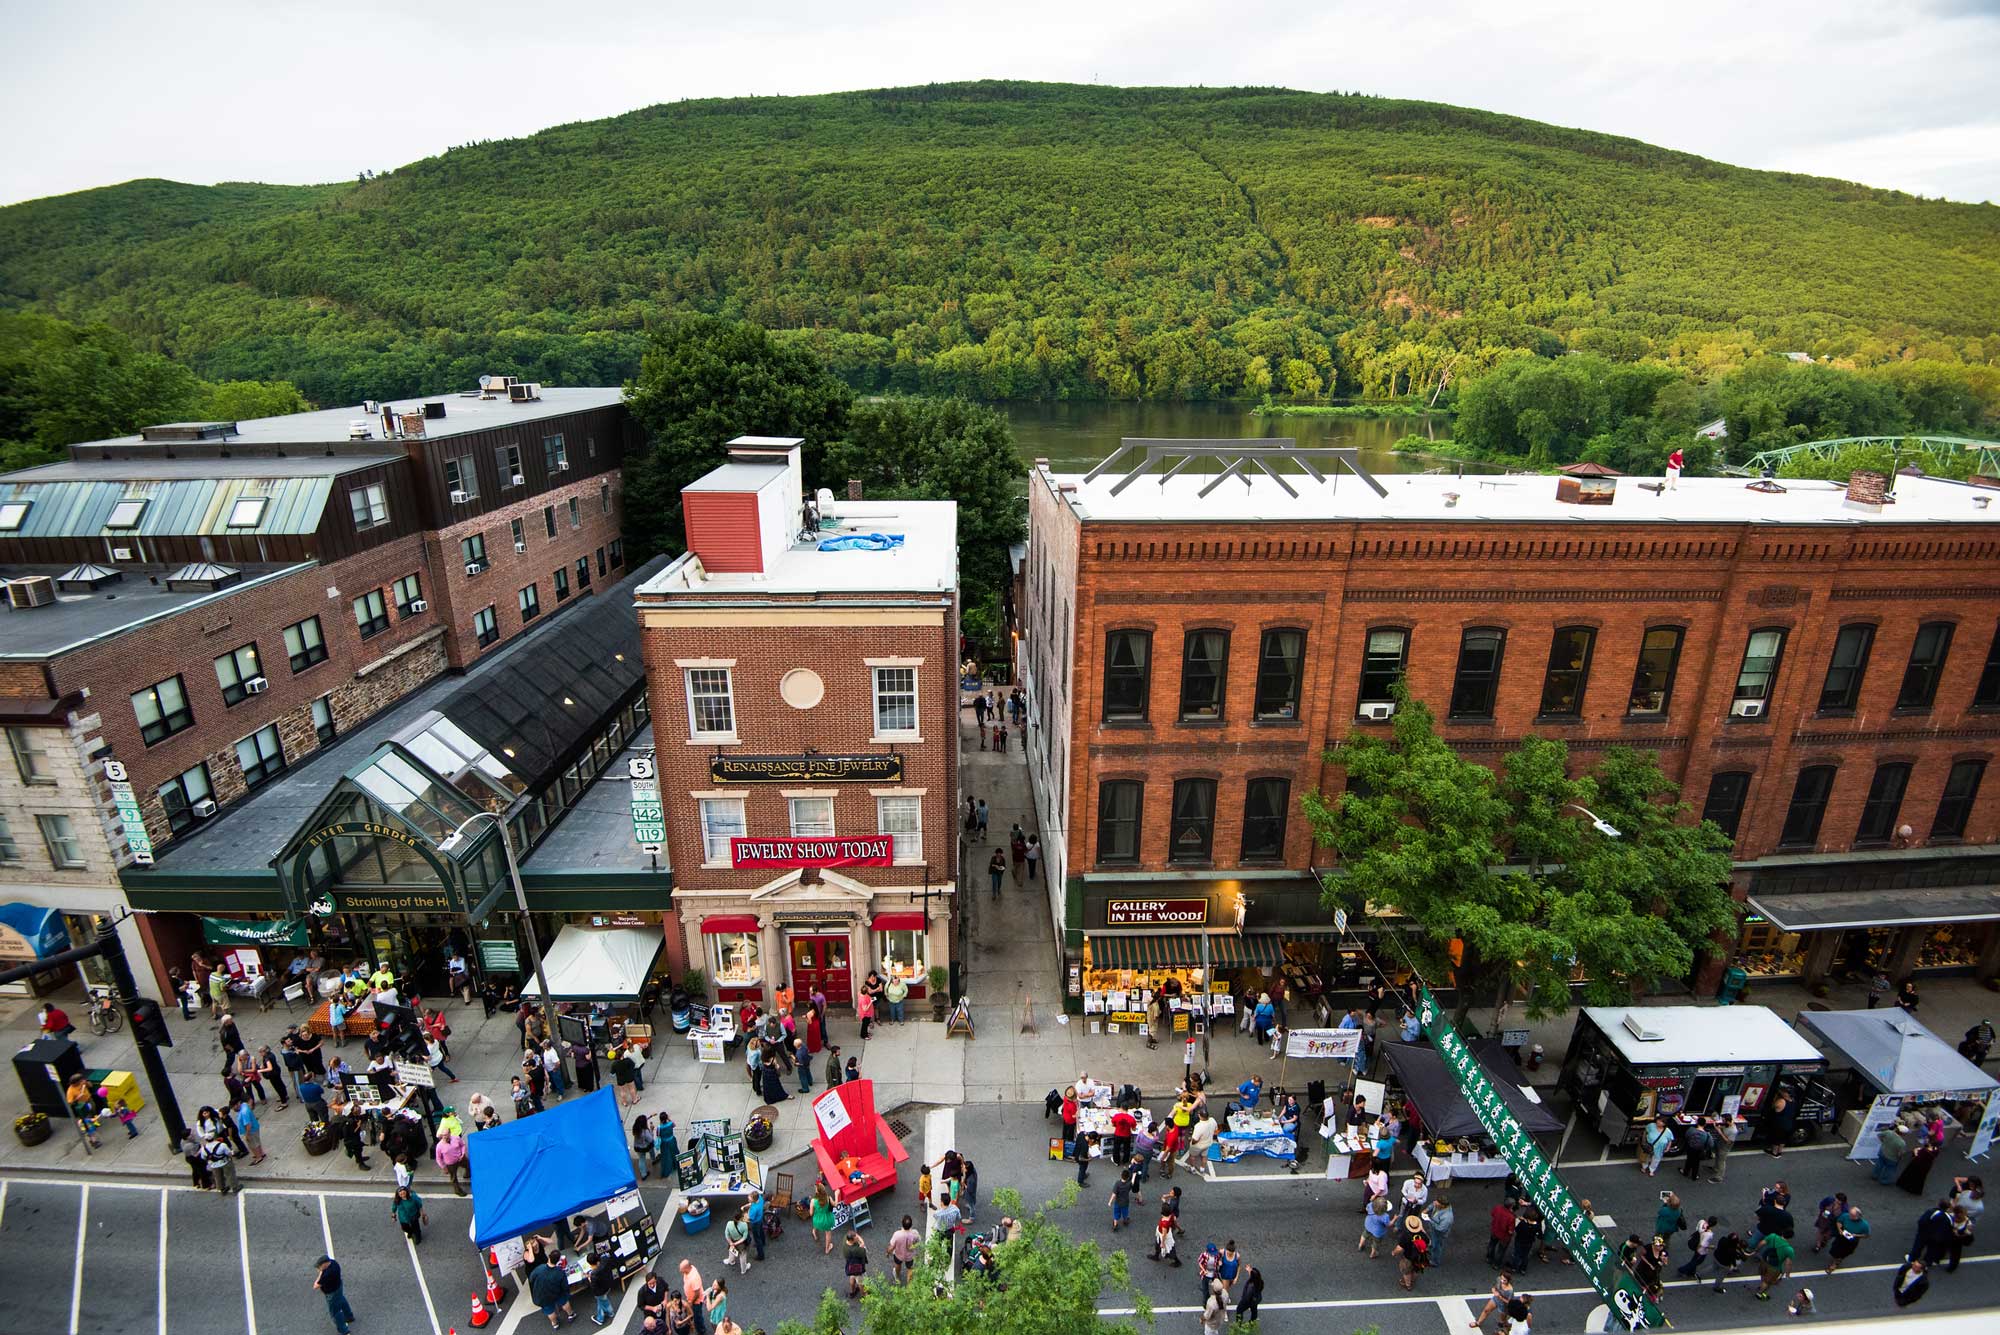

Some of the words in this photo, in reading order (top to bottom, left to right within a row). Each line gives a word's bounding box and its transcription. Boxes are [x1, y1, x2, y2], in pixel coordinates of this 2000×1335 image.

[111, 765, 121, 777] 5
[637, 762, 646, 774] 5
[723, 761, 806, 772] RENAISSANCE
[809, 761, 836, 771] FINE
[838, 760, 890, 773] JEWELRY
[112, 783, 130, 791] NORTH
[633, 781, 654, 789] SOUTH
[120, 793, 130, 801] TO
[125, 809, 134, 821] 9
[636, 809, 659, 820] 142
[364, 823, 416, 847] GARDEN
[640, 829, 660, 840] 119
[736, 843, 794, 863] JEWELRY
[797, 842, 839, 859] SHOW
[841, 840, 888, 858] TODAY
[346, 896, 398, 909] Strolling
[400, 896, 411, 907] of
[411, 896, 434, 907] the
[1111, 902, 1168, 911] GALLERY
[1111, 912, 1125, 922] IN
[1129, 912, 1153, 921] THE
[1157, 911, 1204, 921] WOODS
[1657, 1084, 1685, 1092] Truck
[1461, 1084, 1499, 1143] STROLLING
[1500, 1145, 1513, 1161] OF
[1514, 1162, 1531, 1191] THE
[1533, 1191, 1571, 1245] HEIFERS
[1572, 1249, 1593, 1276] JUNE
